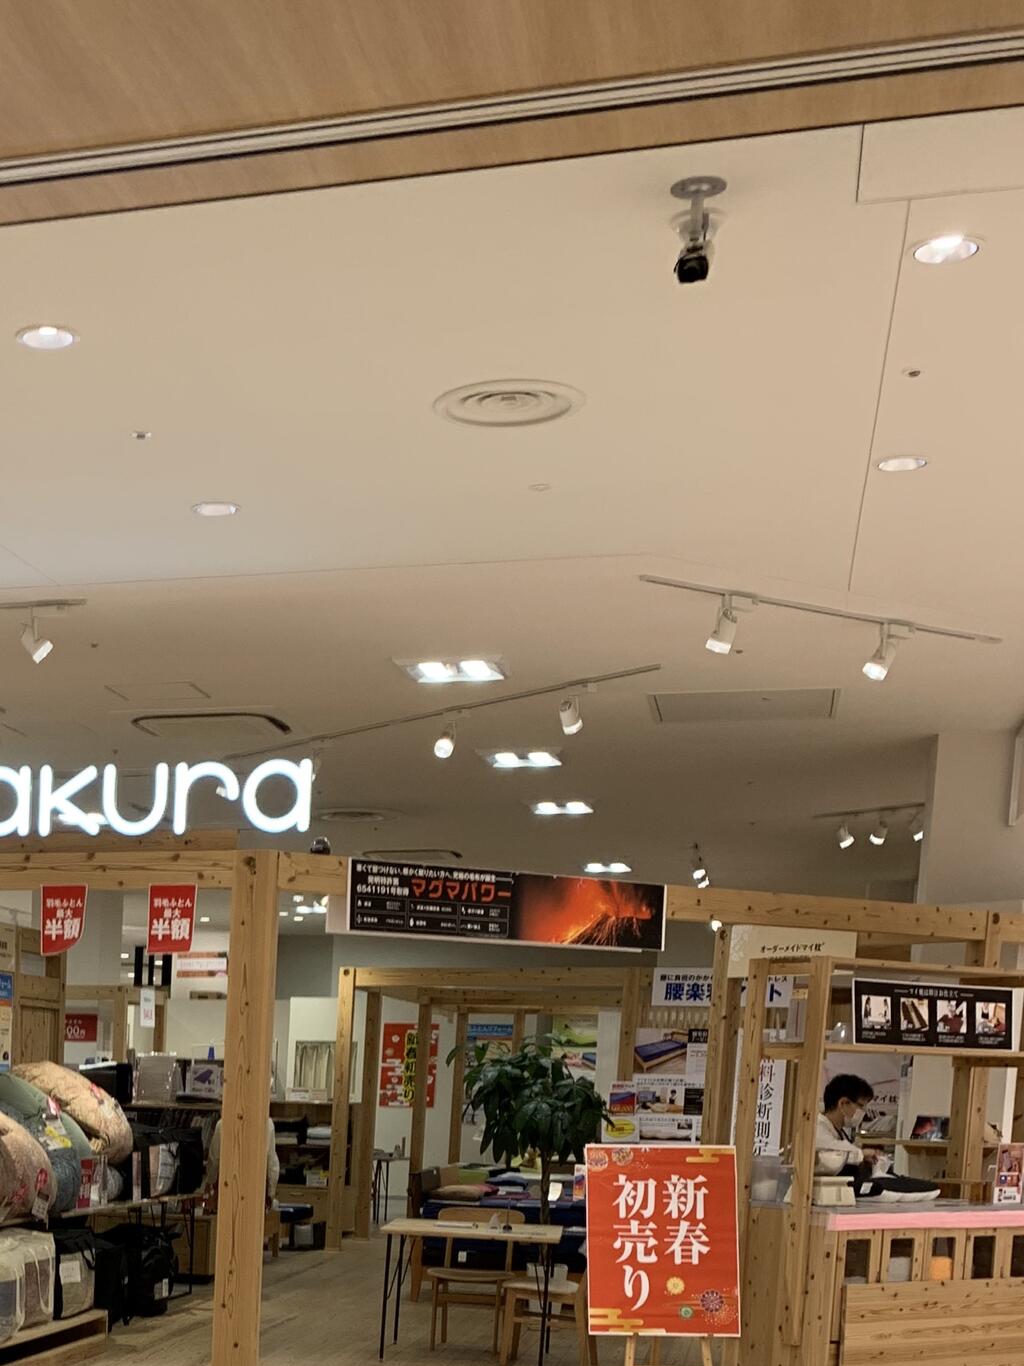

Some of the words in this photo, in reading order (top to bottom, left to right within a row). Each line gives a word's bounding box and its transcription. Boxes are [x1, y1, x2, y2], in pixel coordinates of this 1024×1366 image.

[411, 877, 511, 903] マグマパワー
[44, 918, 81, 941] 半額
[151, 918, 191, 941] 半額
[662, 1174, 711, 1265] 新春
[612, 1174, 658, 1311] 初売り
